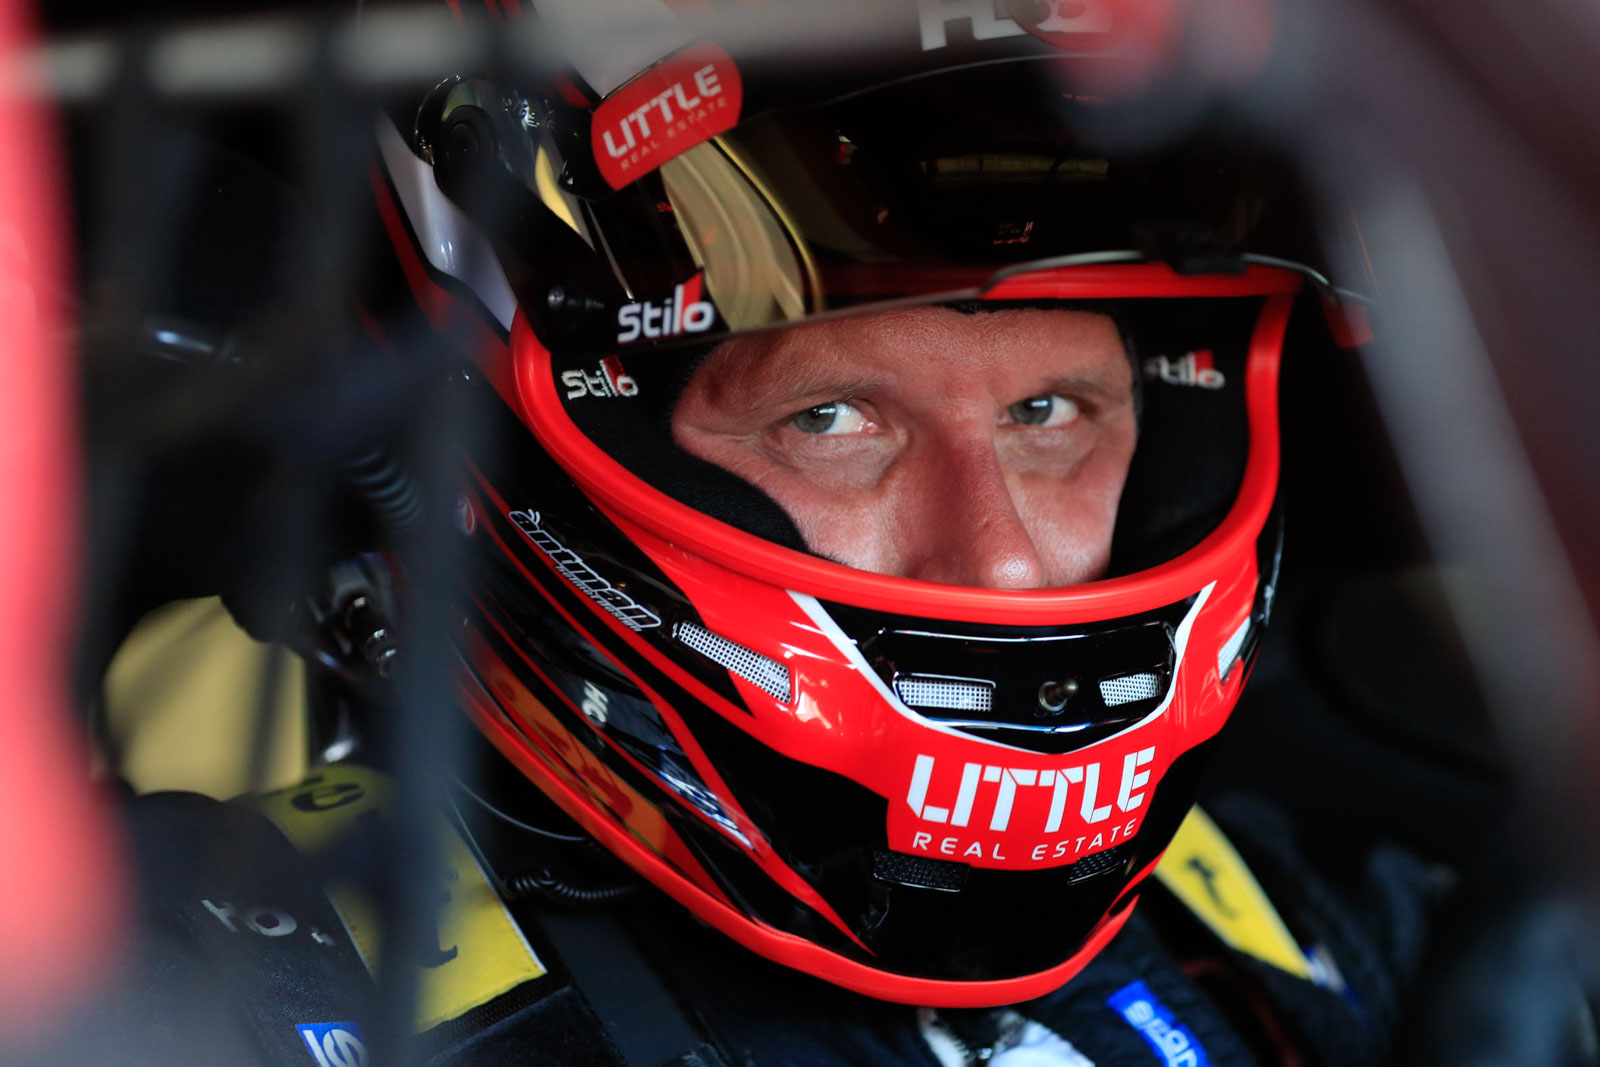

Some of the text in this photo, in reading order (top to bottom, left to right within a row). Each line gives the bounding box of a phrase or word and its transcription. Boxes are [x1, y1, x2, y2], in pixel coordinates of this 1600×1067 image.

[602, 64, 722, 158] LITTLE
[620, 96, 726, 171] REAL ESTATE
[617, 282, 715, 343] Stilo
[561, 359, 638, 400] Stilo
[1143, 351, 1225, 390] tilo
[906, 745, 1156, 833] LITTLE
[912, 818, 1137, 861] REAL ESTATE
